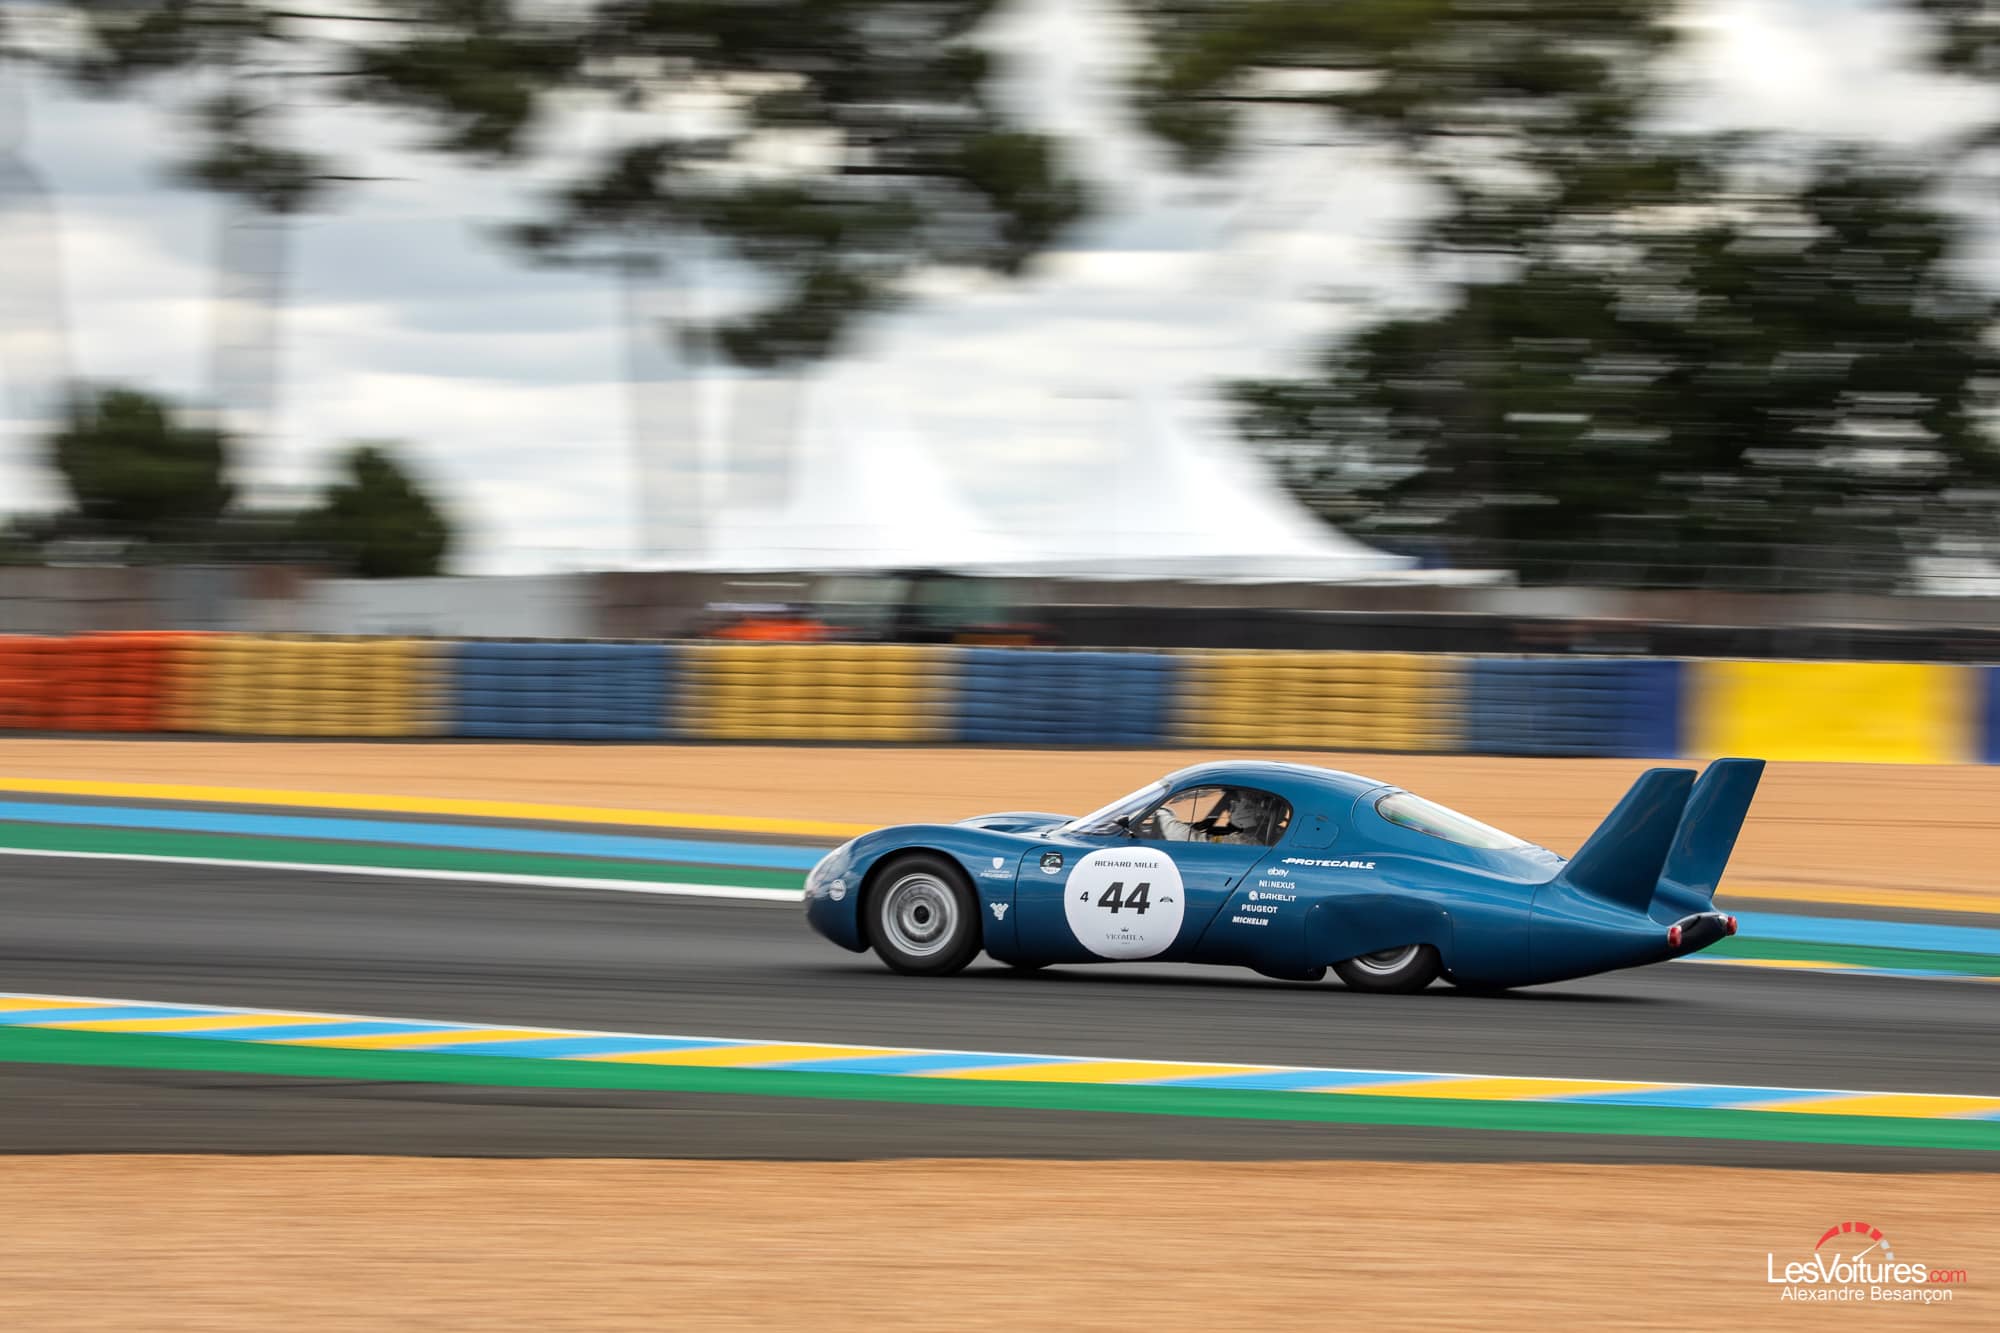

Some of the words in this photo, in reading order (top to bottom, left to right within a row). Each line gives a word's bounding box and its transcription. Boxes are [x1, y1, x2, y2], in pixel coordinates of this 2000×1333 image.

[1282, 857, 1376, 870] PROTECABLE
[1267, 866, 1289, 877] ebay
[1080, 891, 1088, 902] 4
[1097, 881, 1151, 915] 44
[1241, 904, 1278, 914] PEUGEOT
[1232, 915, 1268, 926] MICHELIN
